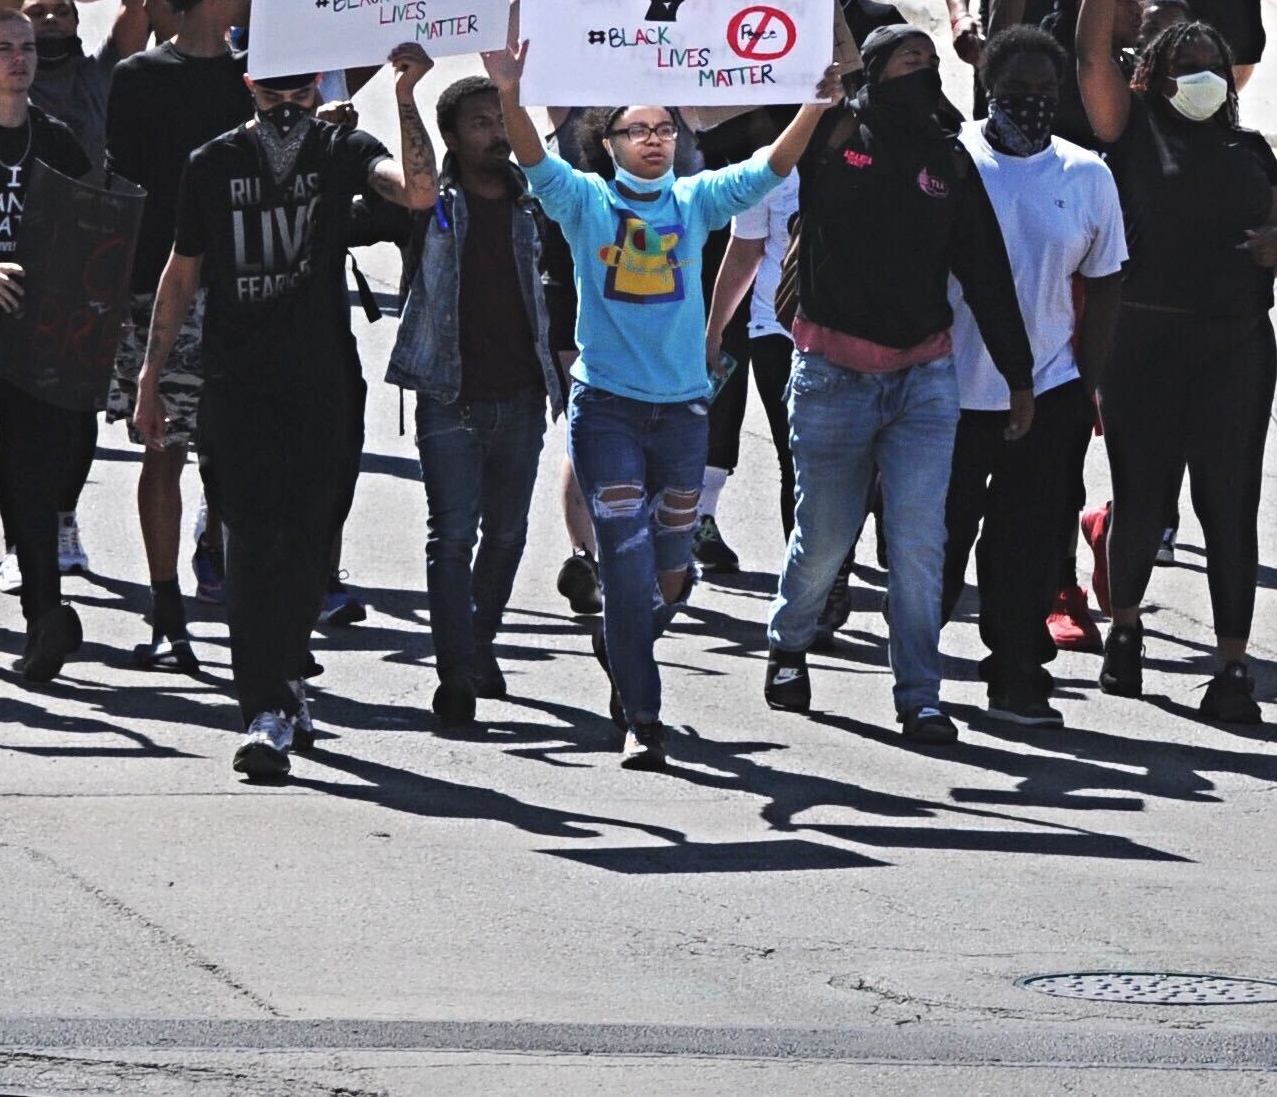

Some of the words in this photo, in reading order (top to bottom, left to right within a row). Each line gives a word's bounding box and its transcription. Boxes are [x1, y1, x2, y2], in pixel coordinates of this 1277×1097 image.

[379, 1, 428, 26] LIVES
[415, 13, 480, 42] MATTER
[586, 26, 672, 49] #BLACK
[656, 47, 711, 69] LIVES
[698, 63, 777, 89] MATTER
[7, 166, 22, 187] I
